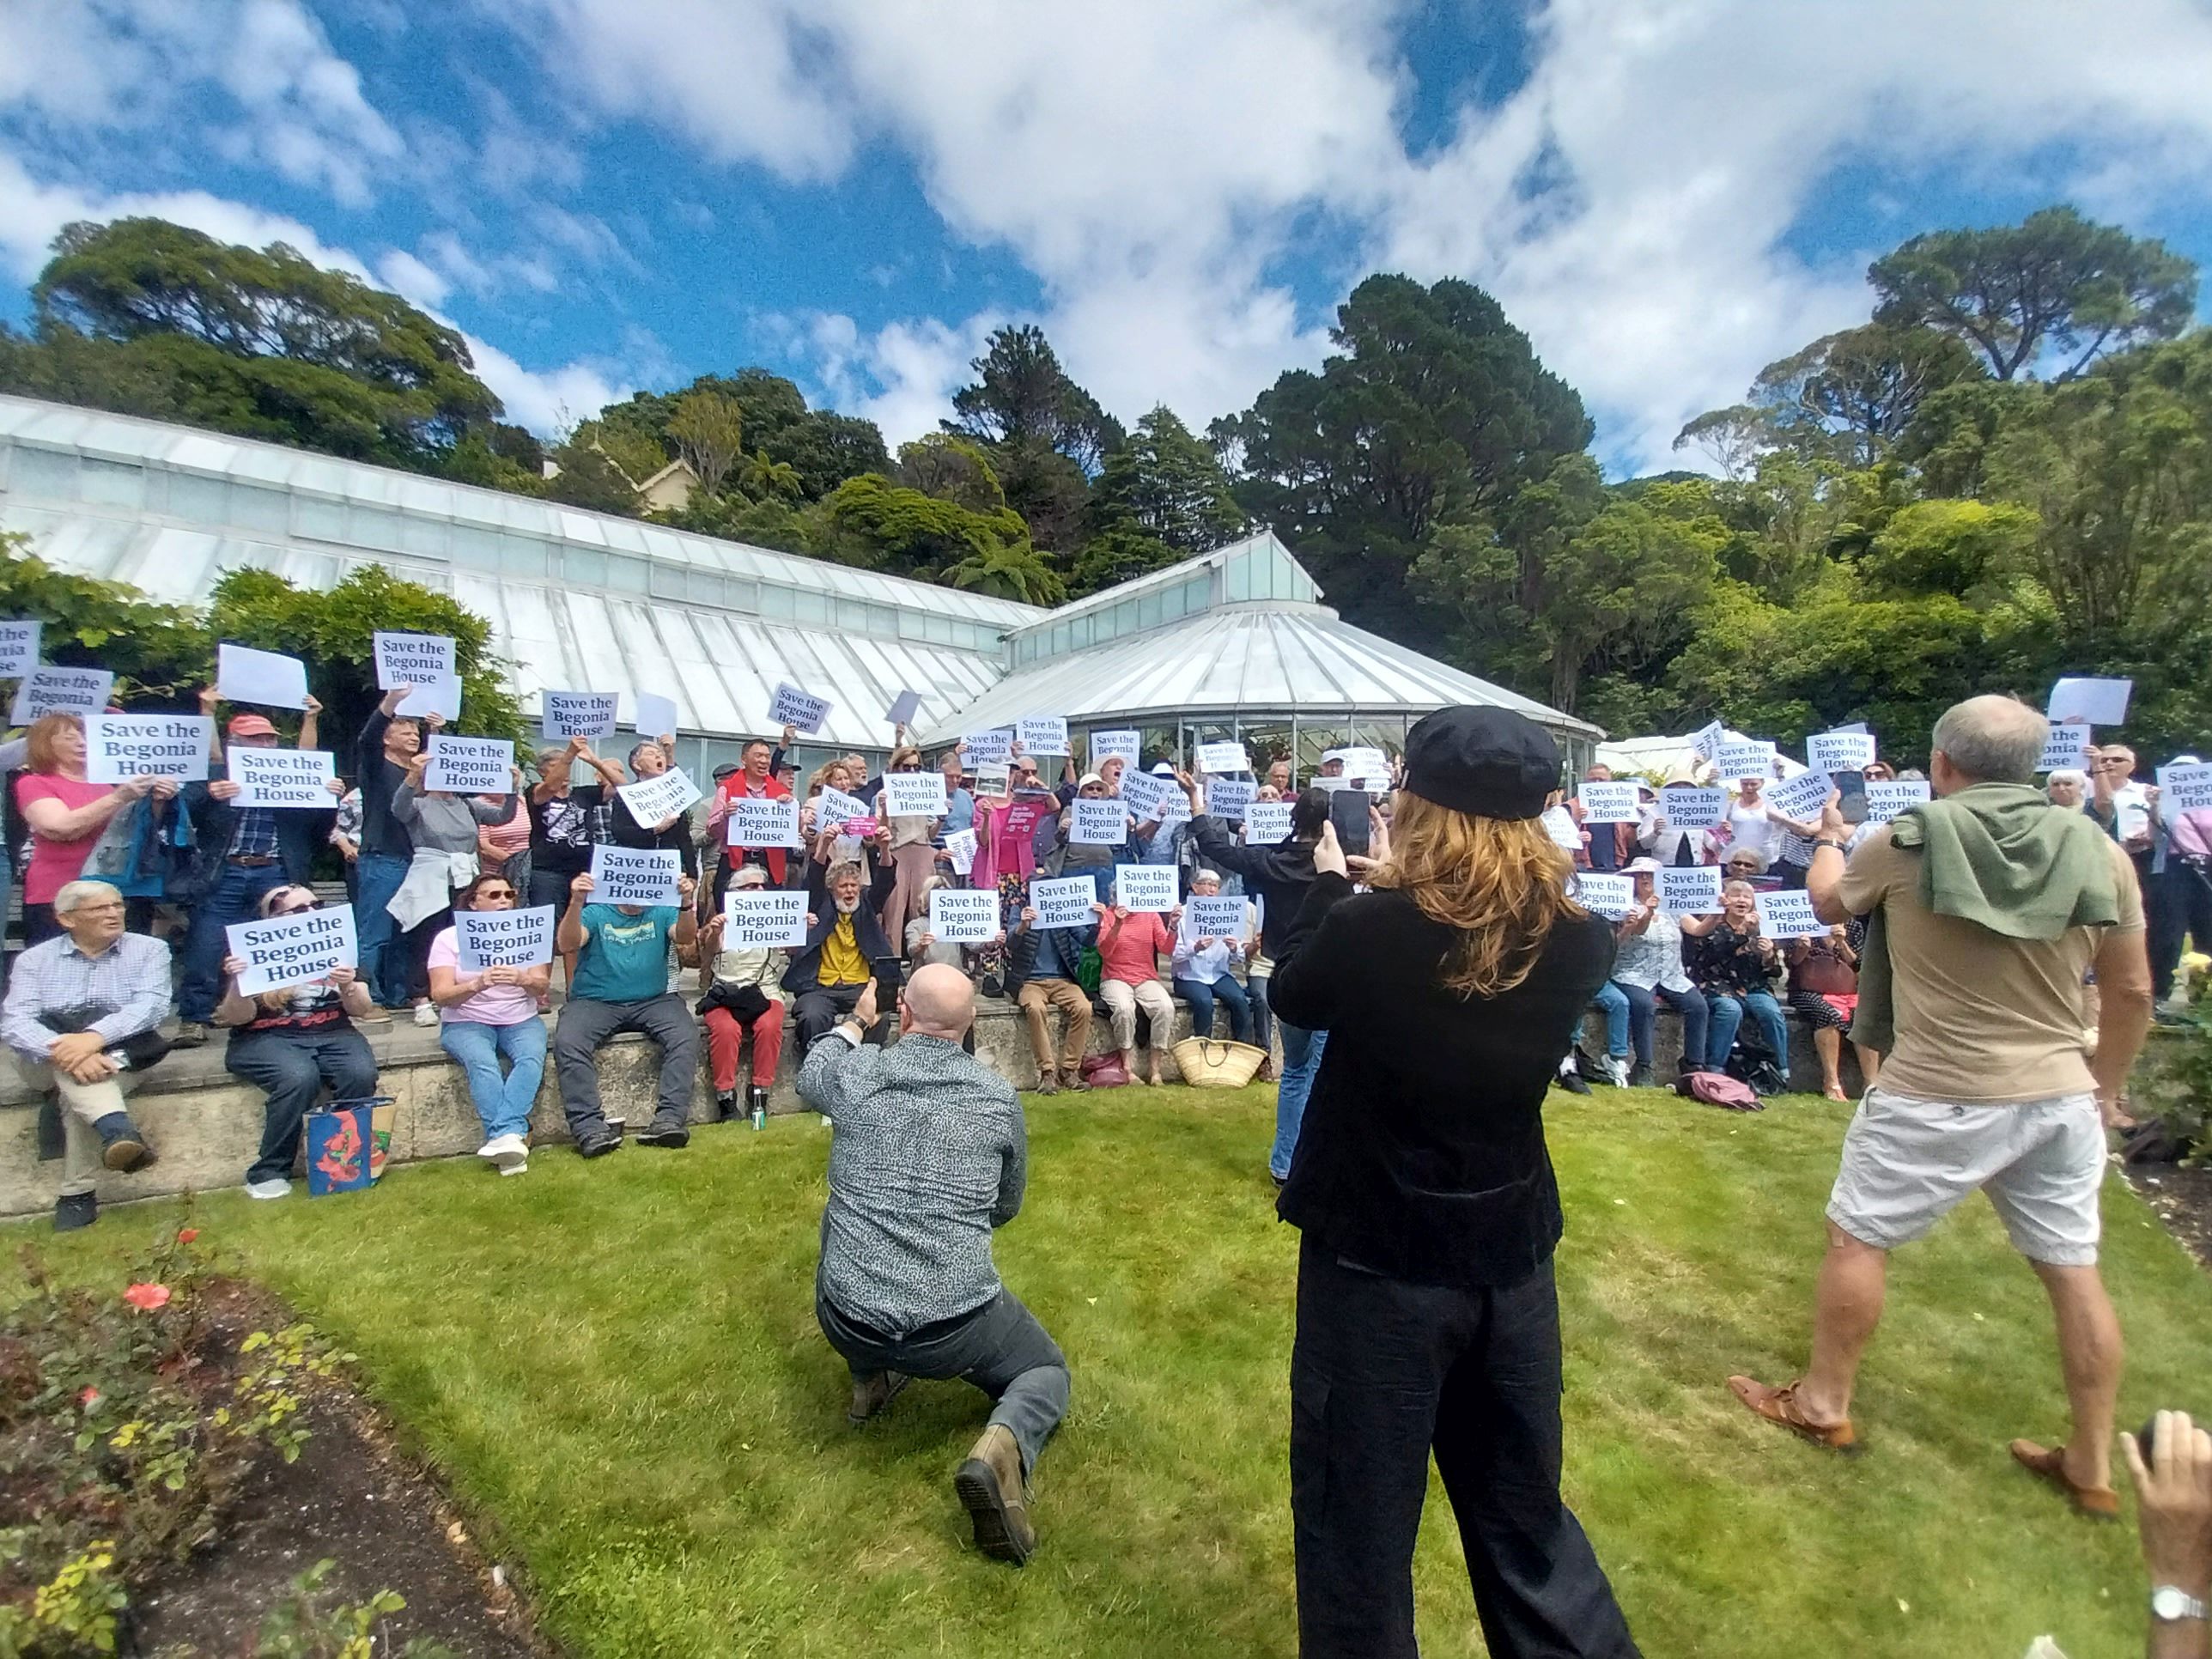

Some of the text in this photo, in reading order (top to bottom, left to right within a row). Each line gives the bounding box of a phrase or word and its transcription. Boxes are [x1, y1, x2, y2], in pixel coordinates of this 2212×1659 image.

[382, 640, 446, 655] Save the
[385, 655, 443, 671] Begonia
[32, 673, 100, 690] Save the
[392, 671, 436, 684] House
[27, 689, 94, 706] Begonia
[550, 696, 612, 709] Save the
[778, 690, 823, 711] Save the
[29, 706, 82, 718] Hoe
[553, 710, 610, 724] Begonia
[775, 701, 818, 721] Begonia
[777, 713, 810, 730] House
[1022, 720, 1062, 730] Save the
[102, 723, 200, 738] Save the
[561, 724, 603, 736] House
[2052, 731, 2079, 741] the
[1024, 732, 1062, 741] Begonia
[1029, 742, 1059, 750] House
[1814, 737, 1868, 749] Save the
[2045, 744, 2078, 754] onia
[105, 742, 197, 759] Begonia
[438, 743, 505, 758] Save the
[967, 745, 1006, 755] Begonia
[1718, 748, 1745, 757] Save
[1817, 749, 1866, 759] Begonia
[241, 755, 323, 770] Save the
[439, 758, 502, 774] Begonia
[1720, 755, 1767, 767] Begonia
[1823, 759, 1863, 769] House
[118, 761, 188, 775] House
[1725, 767, 1763, 776] House
[245, 772, 322, 787] Begonia
[445, 774, 495, 787] House
[2168, 771, 2209, 782] Save
[628, 775, 678, 800] Save the
[891, 778, 938, 788] Save the
[1125, 773, 1147, 787] Save
[1150, 784, 1164, 794] the
[1767, 774, 1820, 800] Save the
[254, 787, 315, 801] House
[894, 790, 938, 801] Begonia
[1122, 783, 1160, 804] Begonia
[1213, 784, 1250, 795] Save the
[1586, 787, 1632, 797] Save the
[1868, 787, 1920, 797] ave the
[2172, 785, 2212, 796] Bego
[635, 785, 685, 811] Begonia
[827, 793, 848, 810] Save
[1212, 794, 1249, 805] Begonia
[1589, 799, 1633, 808] Begonia
[1667, 793, 1720, 803] Save the
[1774, 785, 1826, 810] Begonia
[2181, 798, 2212, 807] Hou
[648, 798, 687, 821] House
[900, 801, 934, 811] House
[1124, 795, 1152, 813] House
[1213, 805, 1243, 815] House
[1786, 799, 1826, 818] House
[738, 804, 791, 817] Save the
[1079, 805, 1122, 816] Save the
[1168, 807, 1189, 816] Hous
[1251, 807, 1291, 817] Save the
[1594, 810, 1630, 818] House
[1668, 805, 1718, 816] Begonia
[738, 817, 790, 830] Begonia
[1079, 817, 1121, 829] Begonia
[1674, 817, 1713, 826] House
[744, 830, 784, 842] House
[1084, 830, 1116, 839] House
[603, 854, 675, 869] Save the
[602, 869, 672, 886] Begonia
[1123, 871, 1171, 881] Save the
[1662, 872, 1716, 884] Save the
[1037, 883, 1088, 897] Save the
[1126, 884, 1171, 896] Begonia
[1580, 881, 1626, 891] ave the
[1664, 885, 1716, 898] Begonia
[608, 886, 663, 899] House
[1577, 892, 1626, 904] Begonia
[734, 897, 799, 911] Save the
[939, 896, 993, 908] Save the
[1039, 897, 1089, 911] Begonia
[1131, 896, 1167, 907] House
[1194, 901, 1241, 912] Save the
[1668, 898, 1709, 909] House
[1765, 897, 1799, 908] Save
[736, 913, 798, 927] Begonia
[939, 910, 992, 924] Begonia
[1045, 910, 1084, 923] House
[1194, 914, 1239, 926] Begonia
[1768, 910, 1813, 921] Begon
[466, 915, 544, 933] Save the
[1777, 923, 1820, 933] House
[244, 916, 343, 946] Save the
[742, 929, 790, 941] House
[945, 925, 987, 936] House
[1198, 926, 1233, 935] House
[469, 933, 542, 951] Begonia
[250, 935, 344, 966] Begonia
[479, 950, 534, 967] House
[266, 956, 338, 982] House
